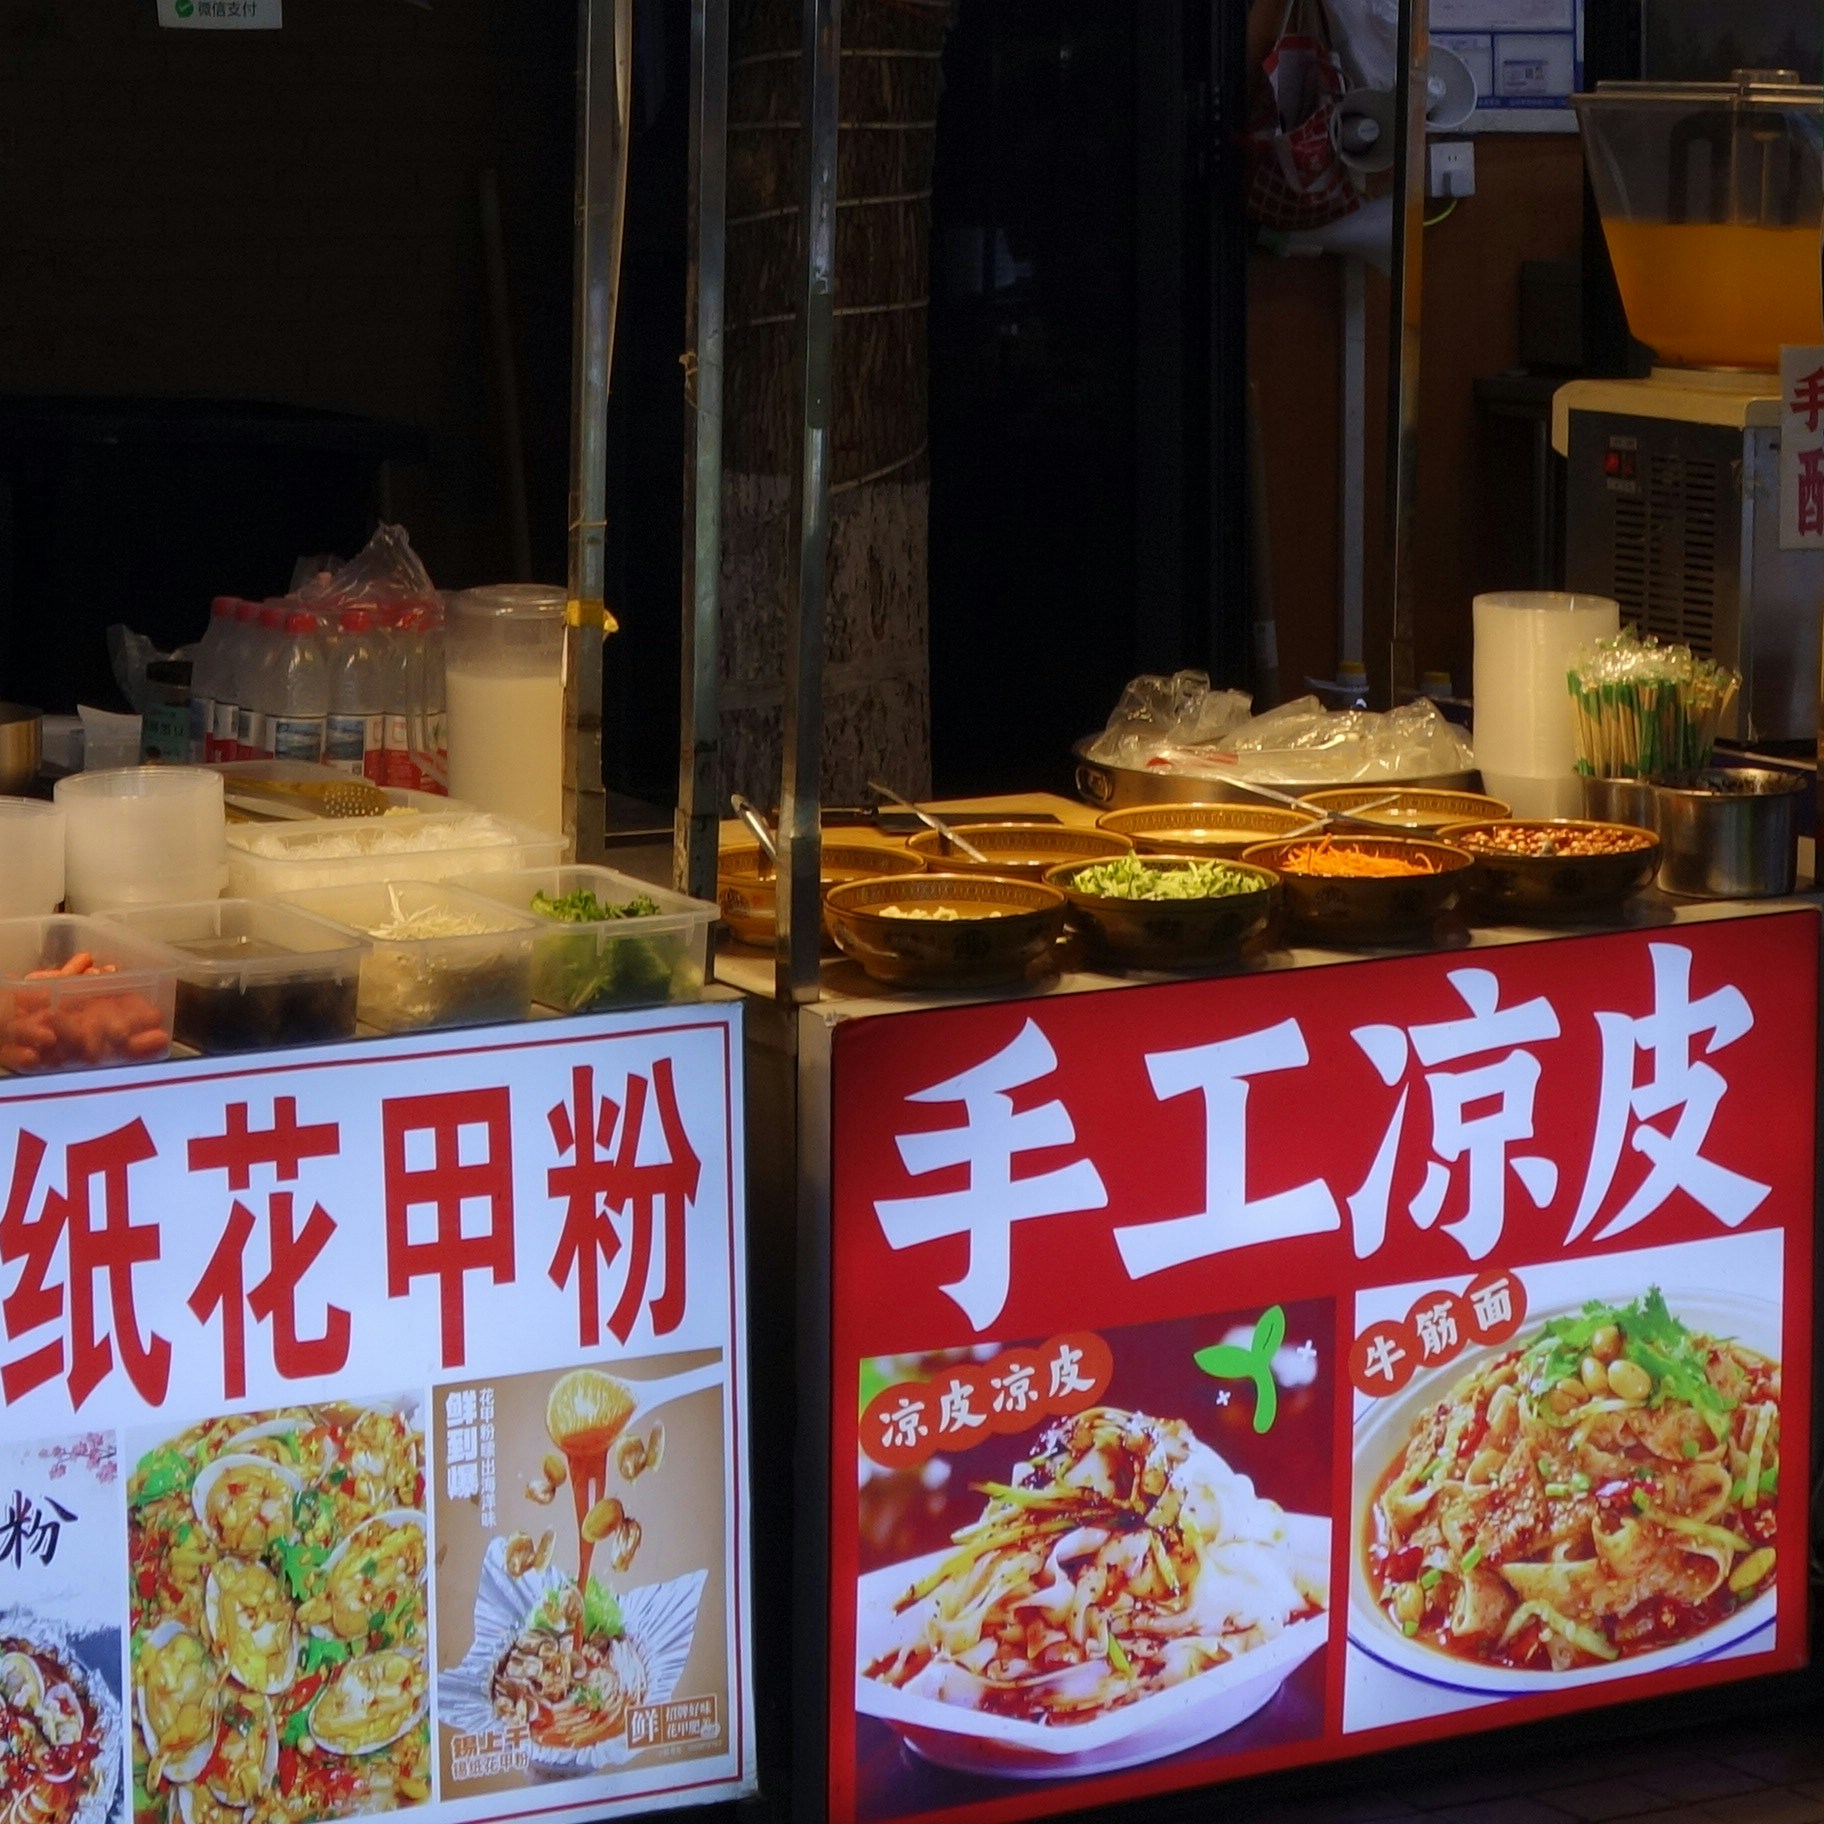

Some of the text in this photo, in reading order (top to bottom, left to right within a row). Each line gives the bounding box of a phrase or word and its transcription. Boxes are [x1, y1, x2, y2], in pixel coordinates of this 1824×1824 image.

[198, 1, 257, 19] 微信支付
[873, 942, 1773, 1330] 手工凉皮
[1364, 1277, 1513, 1383] 牛筋面
[879, 1343, 1096, 1451] 凉皮凉皮
